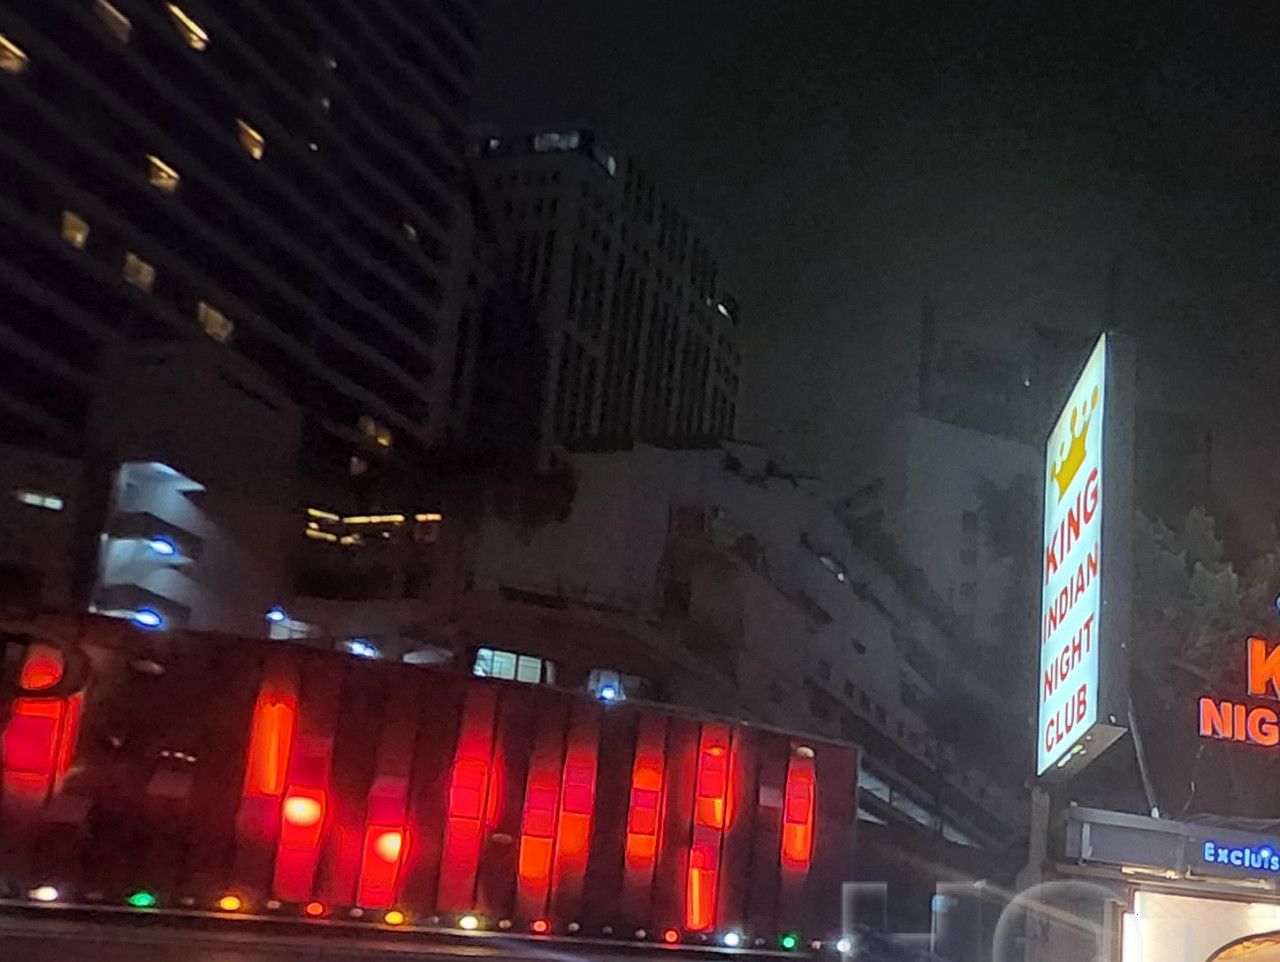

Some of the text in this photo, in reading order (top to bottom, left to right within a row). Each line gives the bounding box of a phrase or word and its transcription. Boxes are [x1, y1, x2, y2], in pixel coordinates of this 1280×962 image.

[1044, 467, 1099, 586] KING
[1043, 544, 1099, 645] INDIAN
[1042, 613, 1095, 703] NIGHT
[1044, 683, 1088, 753] CLUB
